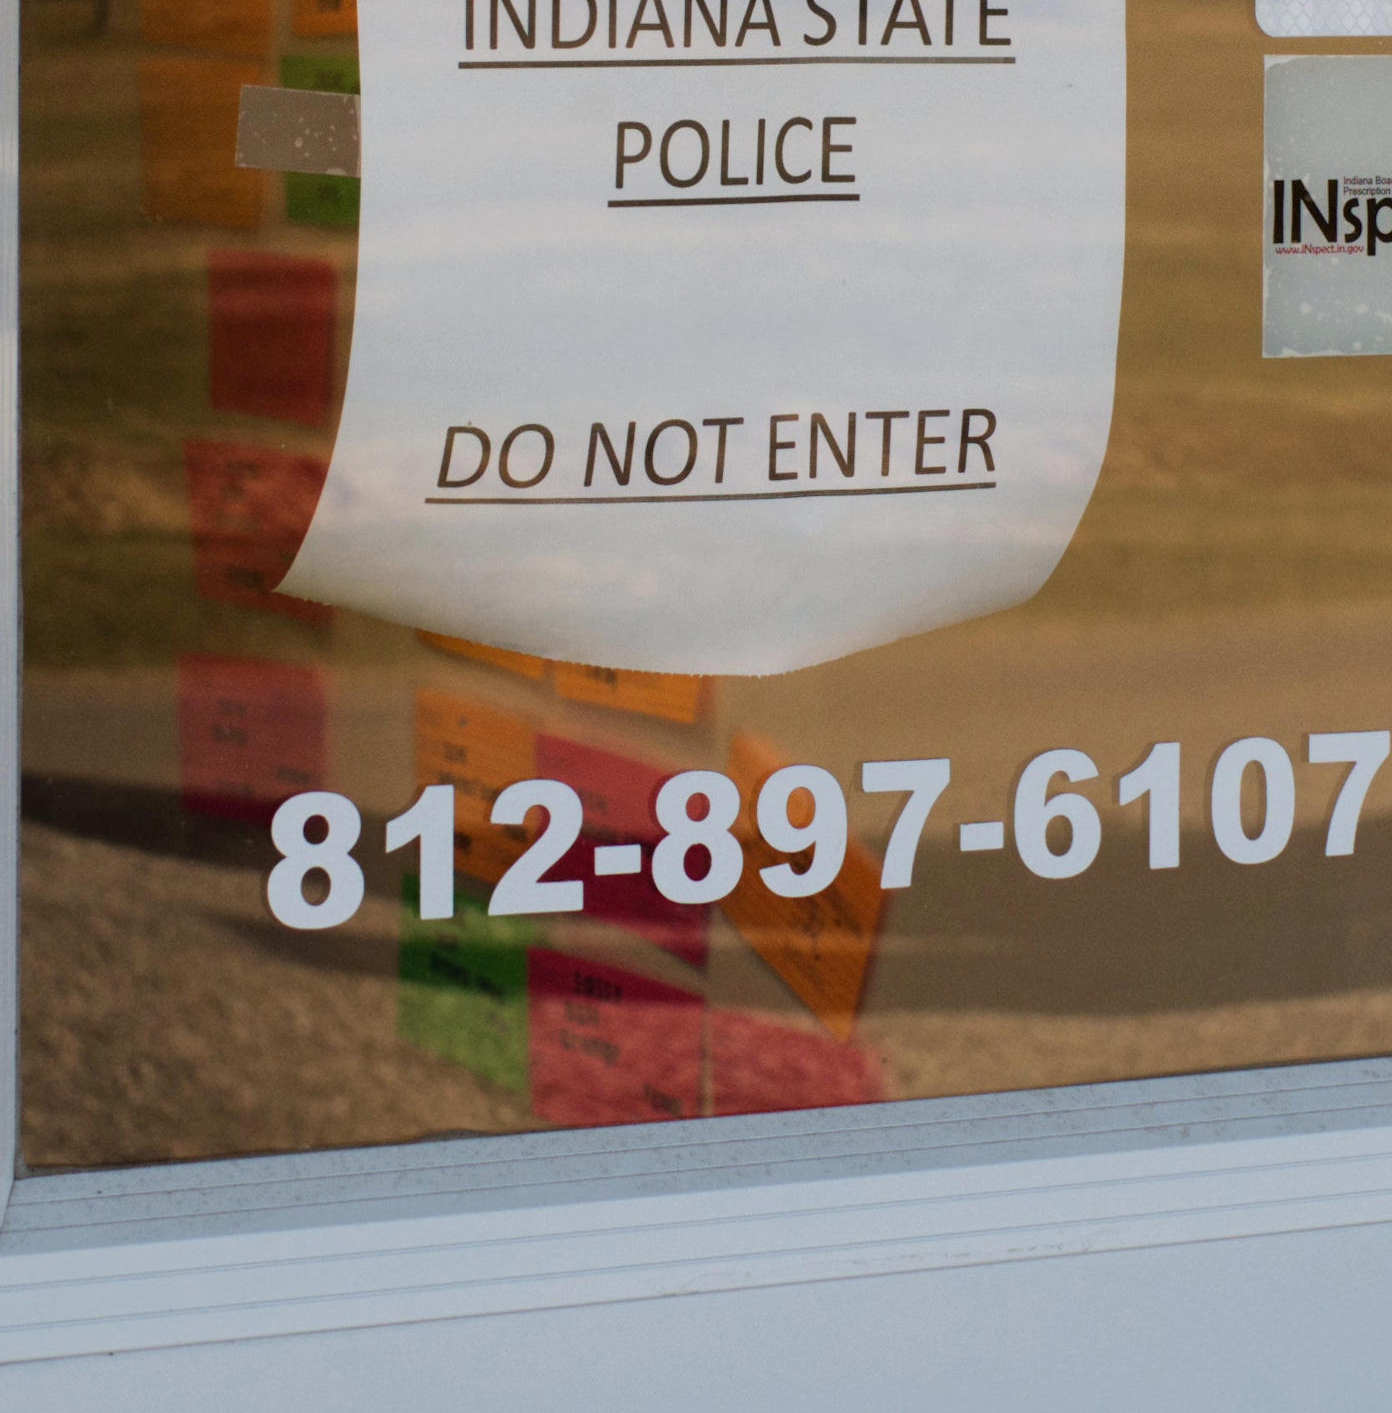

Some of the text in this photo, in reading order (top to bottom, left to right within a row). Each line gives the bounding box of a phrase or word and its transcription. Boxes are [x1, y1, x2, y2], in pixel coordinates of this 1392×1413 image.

[614, 116, 858, 190] POLICE
[1343, 176, 1373, 186] Indiana
[1343, 187, 1391, 197] Prescription
[437, 408, 996, 488] DO NOT ENTER
[265, 730, 1391, 931] 812-897-6107
